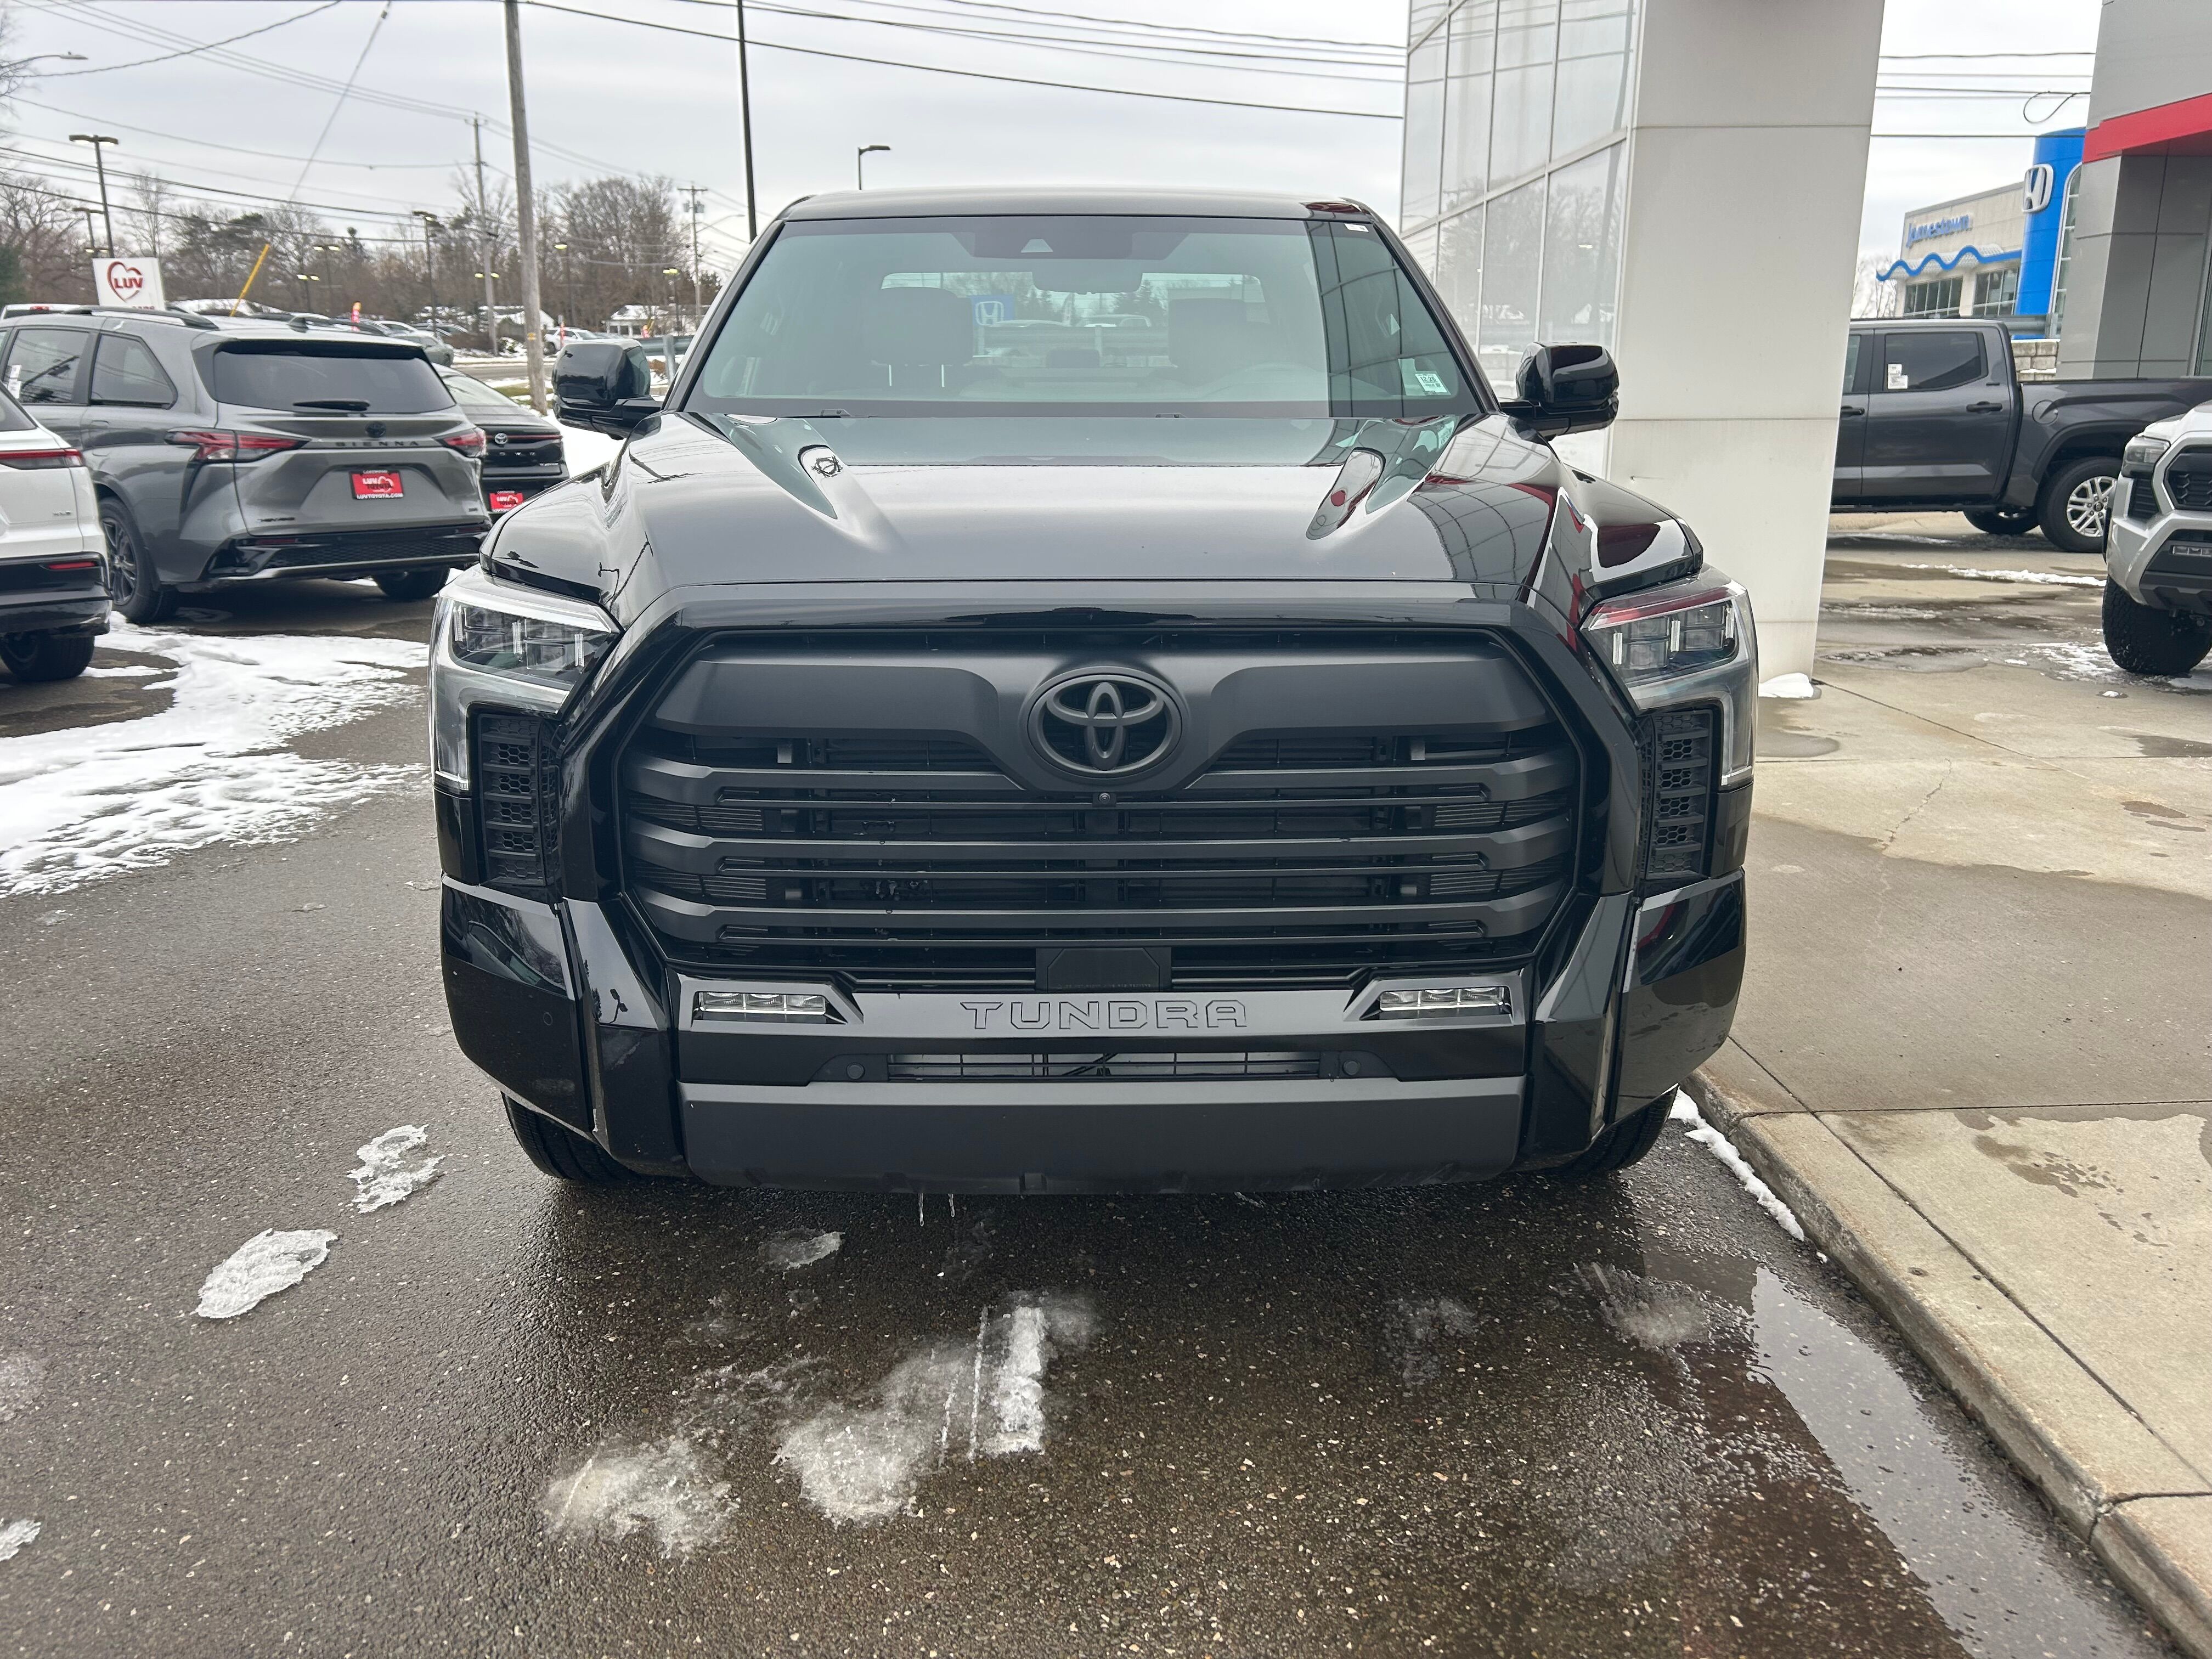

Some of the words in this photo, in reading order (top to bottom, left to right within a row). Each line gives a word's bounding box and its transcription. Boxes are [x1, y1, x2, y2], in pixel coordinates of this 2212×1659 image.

[1905, 215, 1969, 248] Jamestown
[114, 277, 143, 288] LUV
[960, 1000, 1247, 1030] TUNDRA
